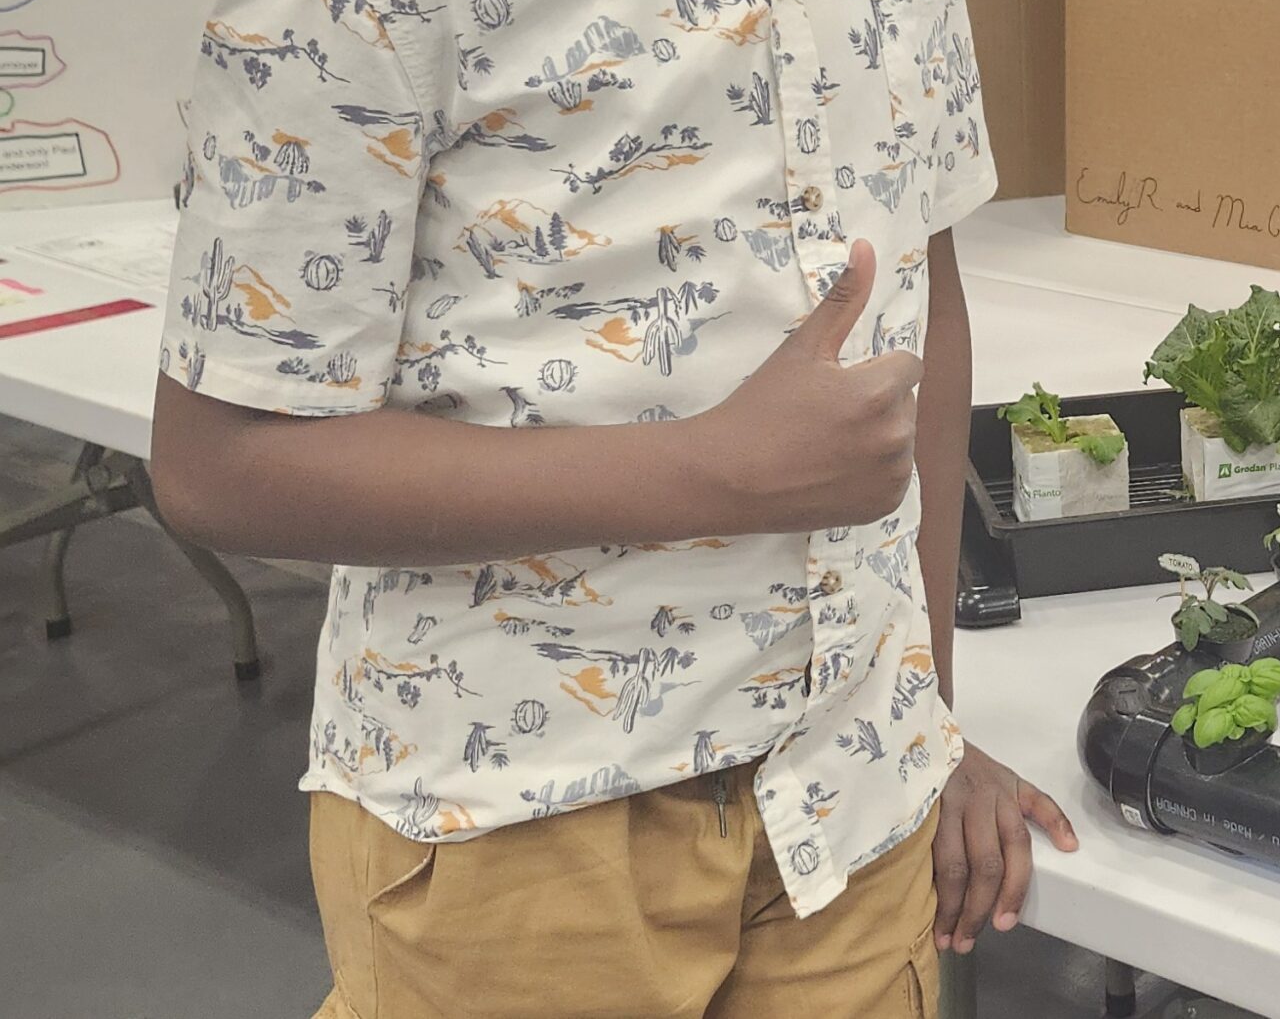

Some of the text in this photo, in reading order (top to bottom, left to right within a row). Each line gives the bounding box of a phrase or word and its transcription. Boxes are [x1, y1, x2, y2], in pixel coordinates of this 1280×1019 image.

[1176, 190, 1202, 214] and
[1212, 194, 1263, 232] Mia
[1234, 463, 1266, 474] Grodan
[1168, 558, 1193, 571] TOMATO
[1156, 796, 1198, 821] CANADA
[1203, 812, 1215, 824] in
[1223, 819, 1253, 841] Made
